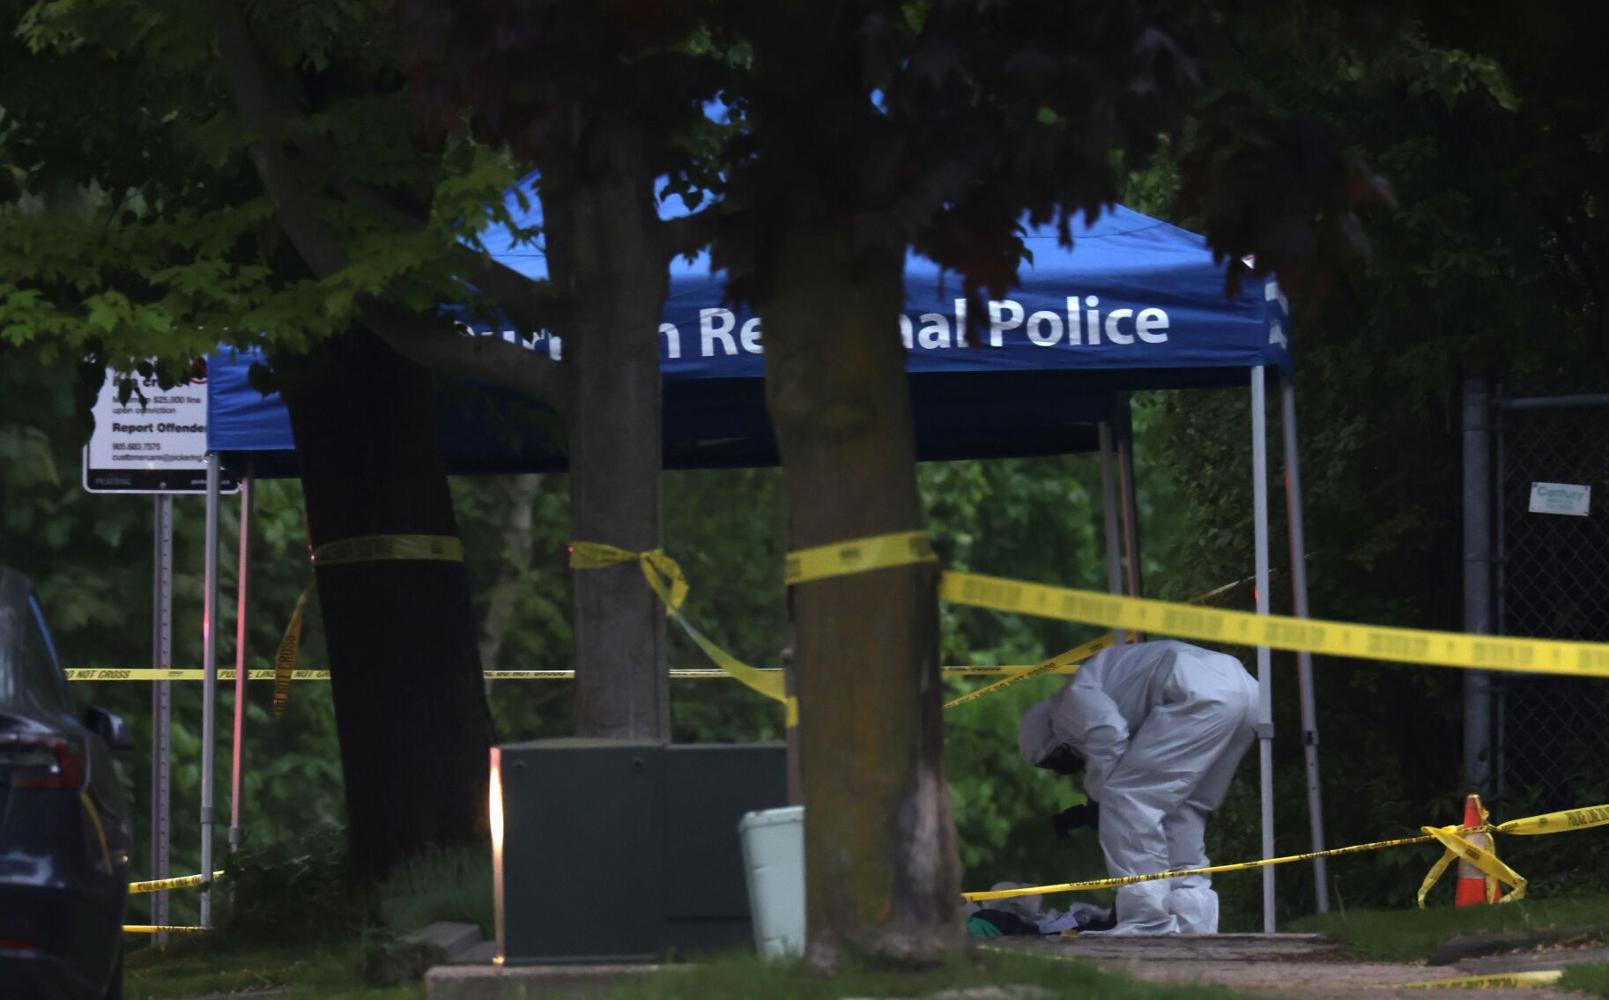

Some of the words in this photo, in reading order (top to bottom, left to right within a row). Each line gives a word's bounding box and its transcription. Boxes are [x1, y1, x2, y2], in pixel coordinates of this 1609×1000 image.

[699, 297, 970, 357] Real
[988, 294, 1170, 348] Police
[112, 423, 153, 434] Report
[157, 423, 206, 433] Offende
[98, 670, 131, 679] CROSS
